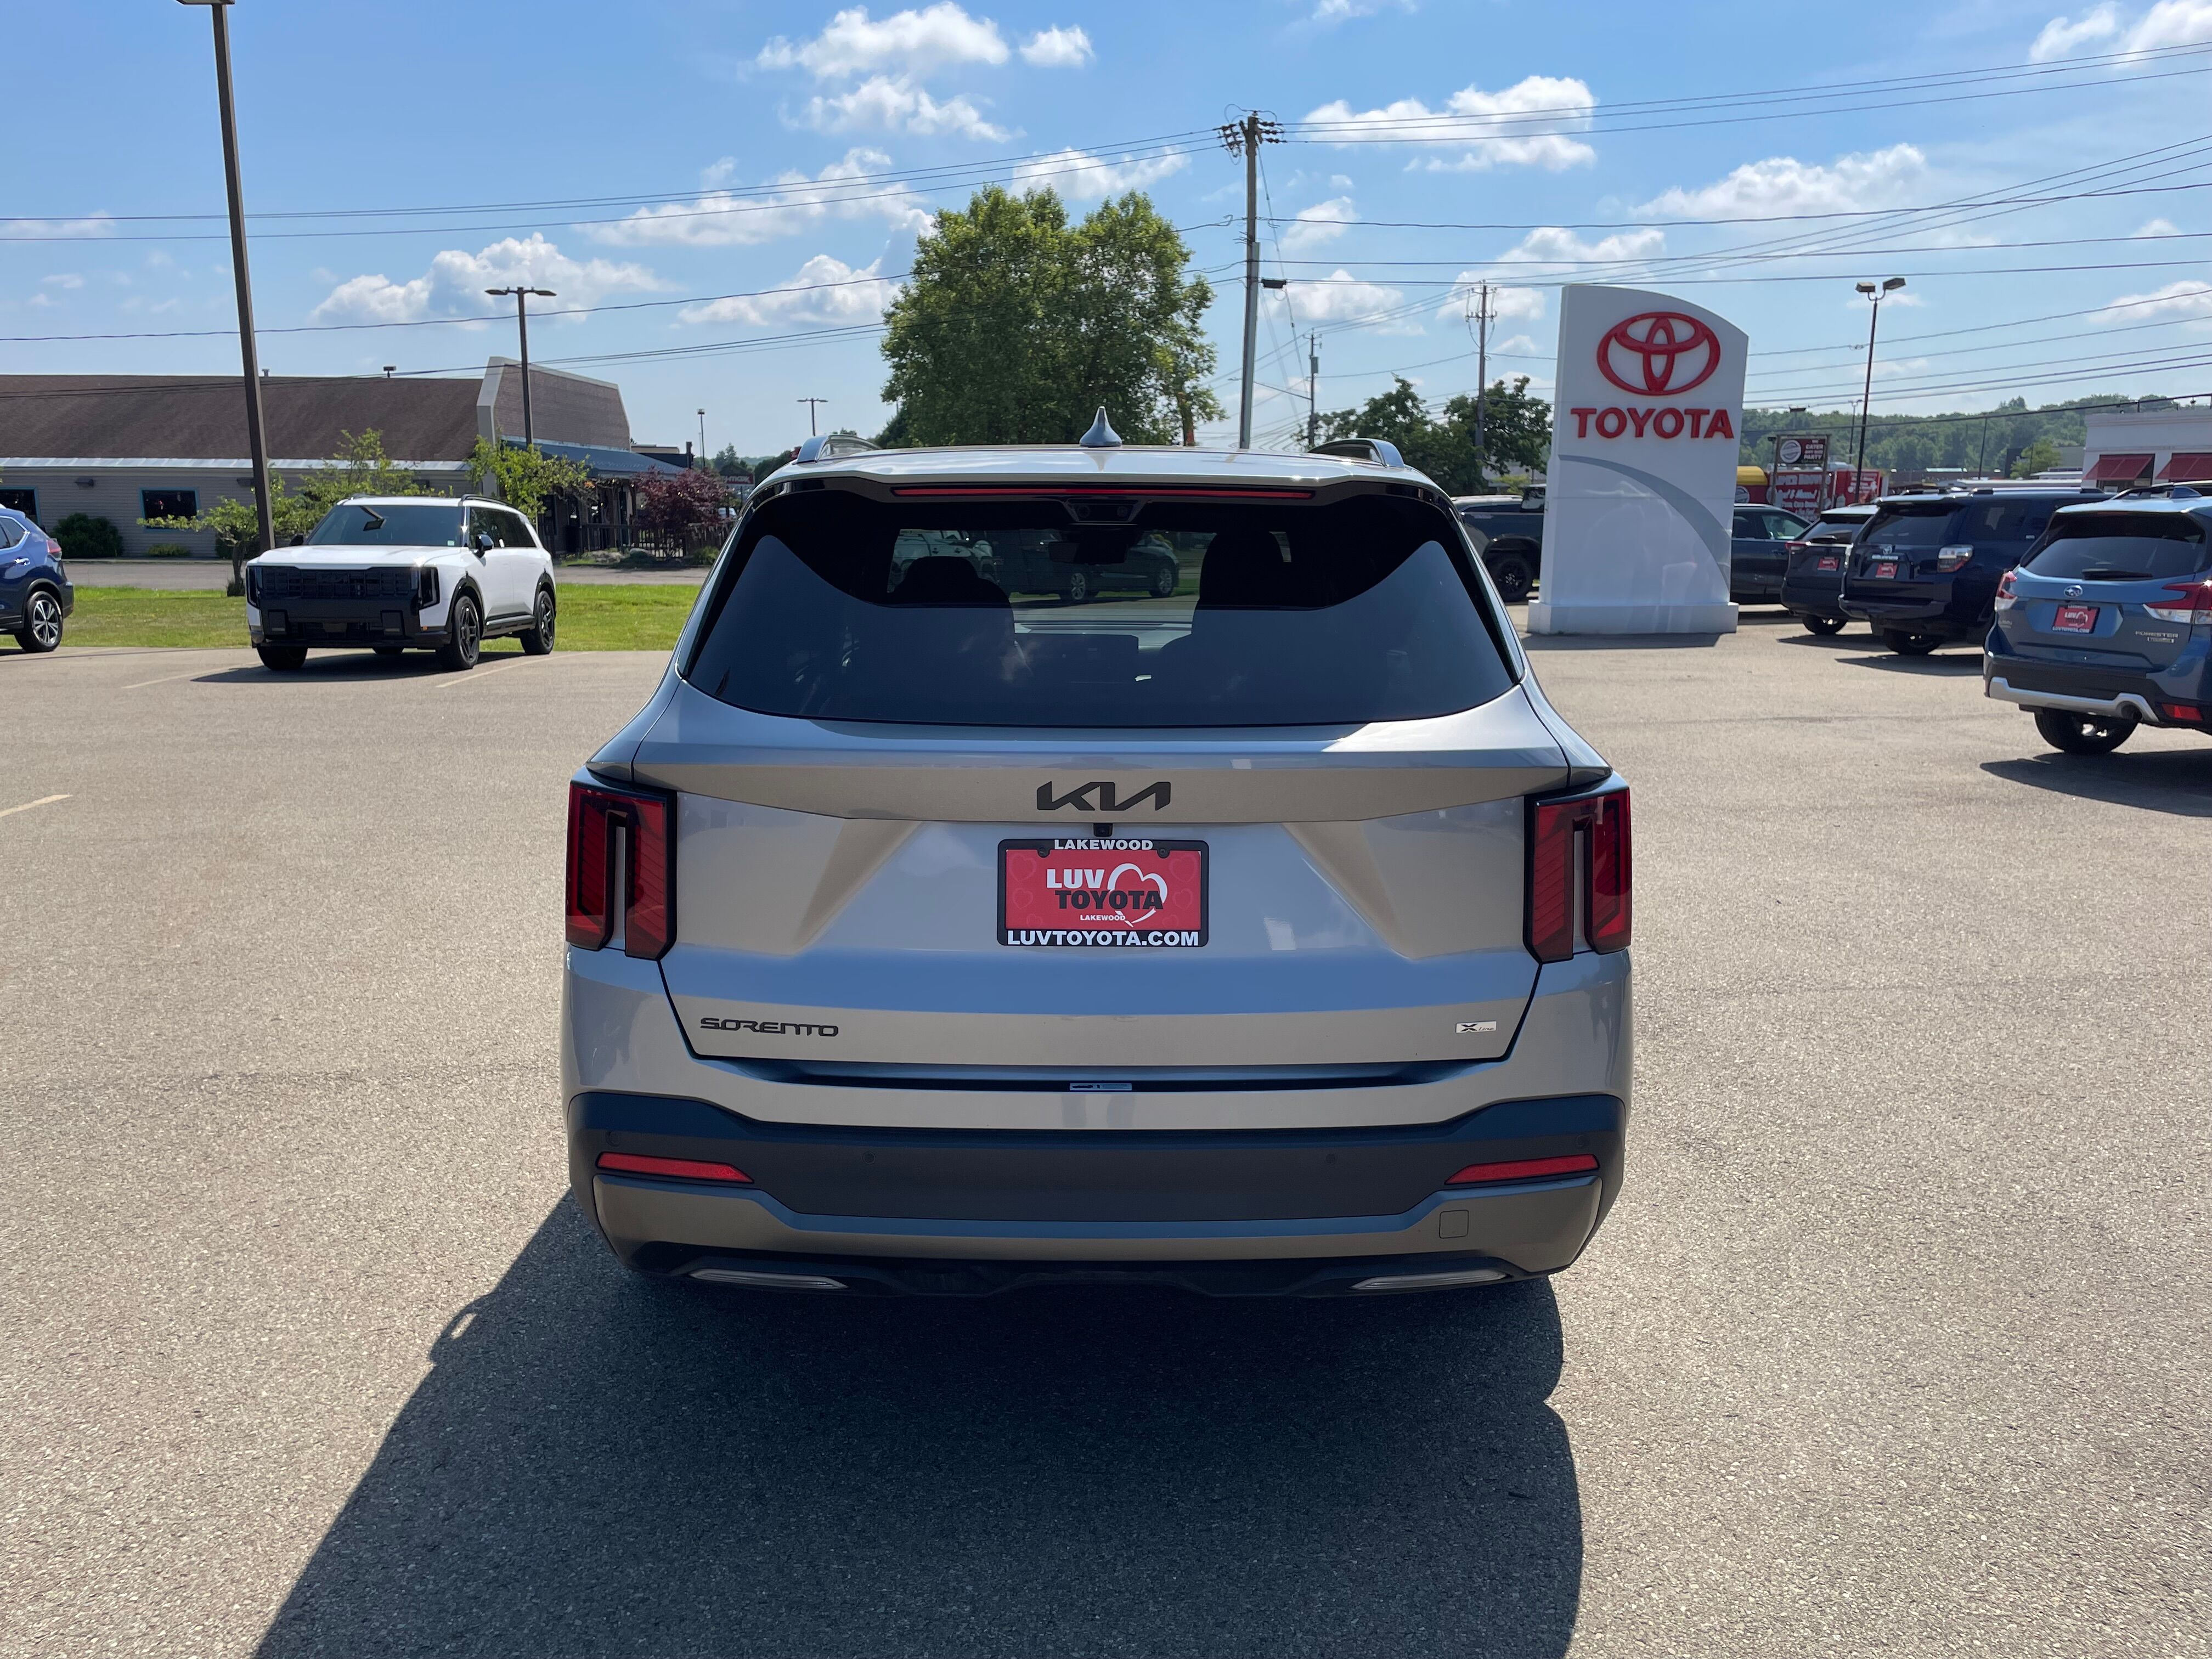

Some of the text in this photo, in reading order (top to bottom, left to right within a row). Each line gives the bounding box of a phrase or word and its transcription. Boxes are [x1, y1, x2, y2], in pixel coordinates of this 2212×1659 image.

[1571, 407, 1734, 439] TOYOTA
[1037, 781, 1171, 811] KIA
[1054, 839, 1153, 850] LAKEWOOD
[1047, 868, 1105, 889] LUV
[1055, 890, 1164, 910] TOYOTA
[1007, 930, 1199, 946] LUVTOYOTA.COM
[700, 1017, 839, 1037] SORENTO
